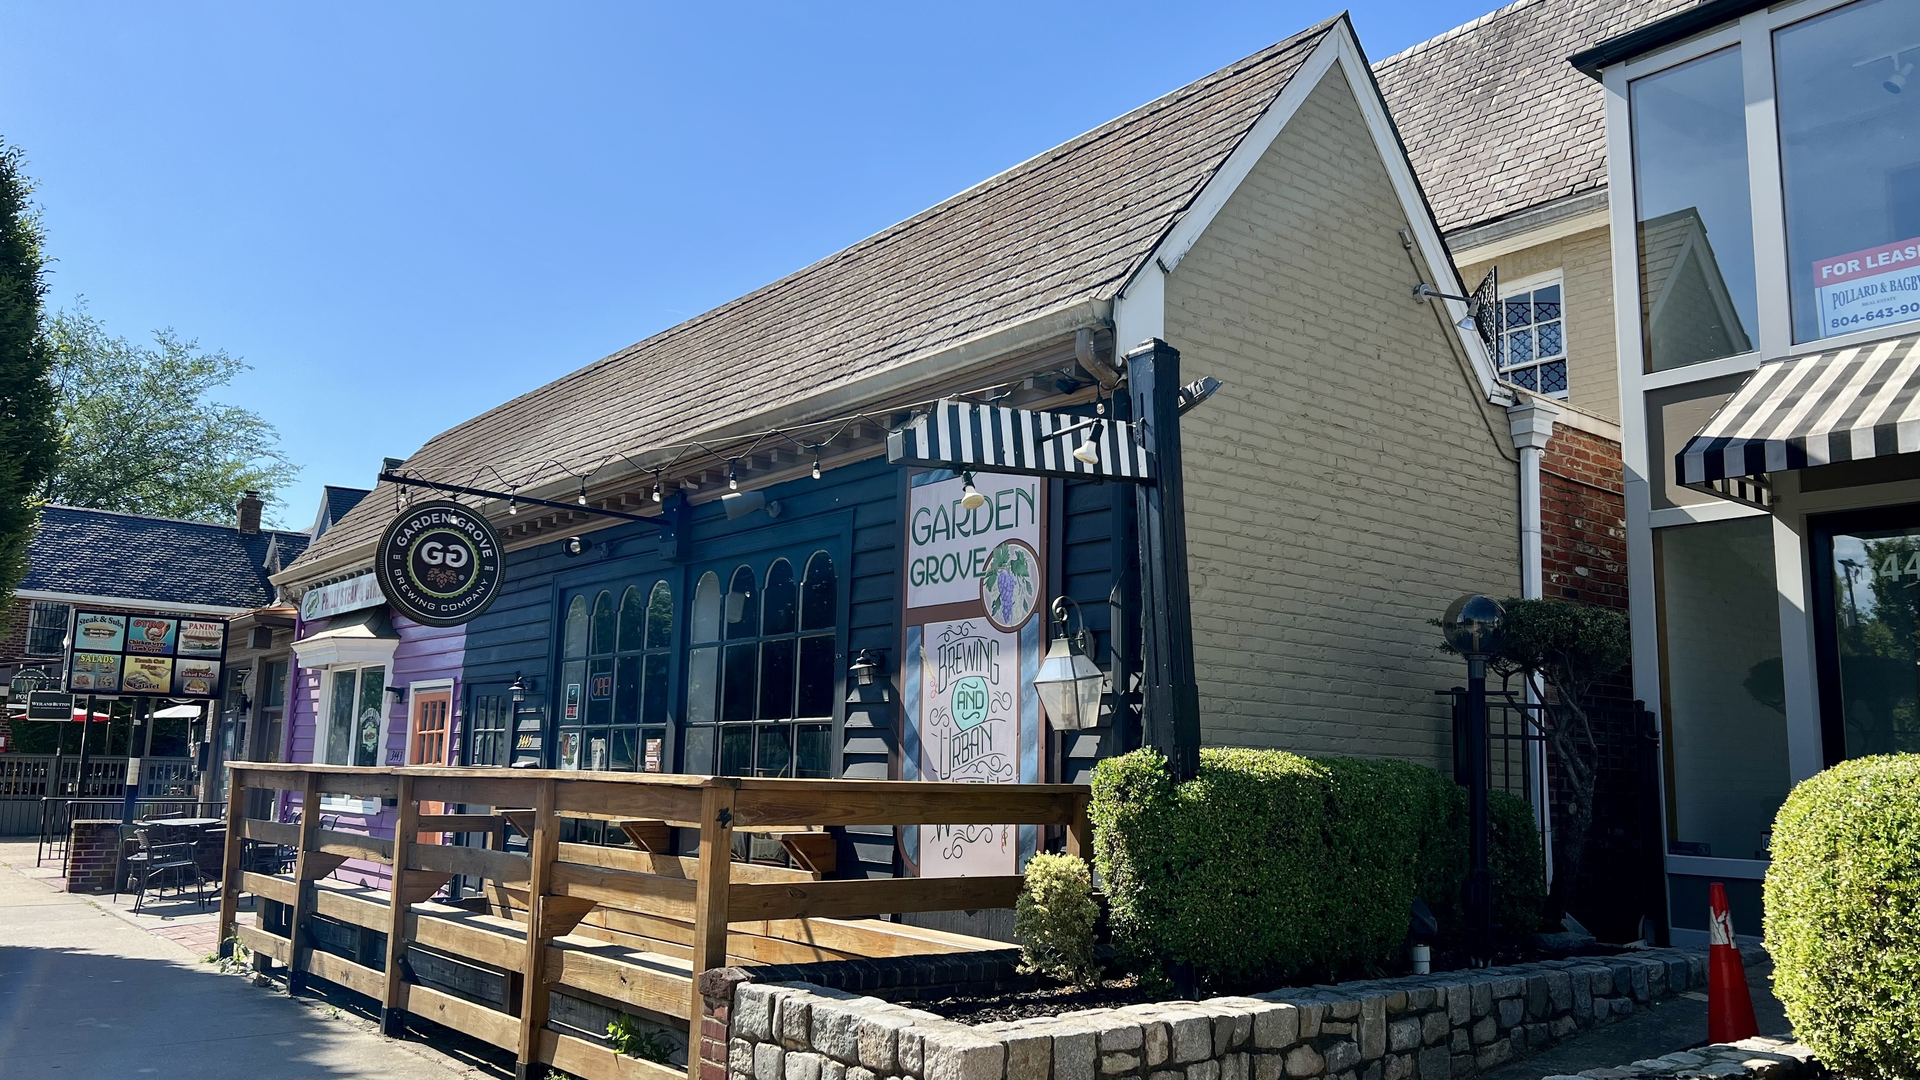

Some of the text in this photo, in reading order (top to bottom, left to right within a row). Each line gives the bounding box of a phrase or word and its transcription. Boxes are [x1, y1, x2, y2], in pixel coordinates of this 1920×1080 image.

[1821, 259, 1861, 279] FOR
[1831, 286, 1878, 310] POLLARD
[1880, 282, 1888, 300] &
[1876, 296, 1897, 304] ESTATE
[1831, 302, 1920, 329] 804-643-90
[911, 483, 1036, 546] GARDEN
[395, 512, 494, 558] GARDEN GROVE
[910, 546, 987, 588] GROVE
[394, 568, 489, 611] BREWING COMPANY
[78, 615, 124, 629] Steak & Subs
[133, 618, 166, 629] GYRO
[188, 622, 218, 631] PANINI
[80, 654, 115, 664] SALADS
[937, 638, 1000, 695] BREWING
[957, 690, 985, 710] AND
[939, 722, 993, 780] URBAN
